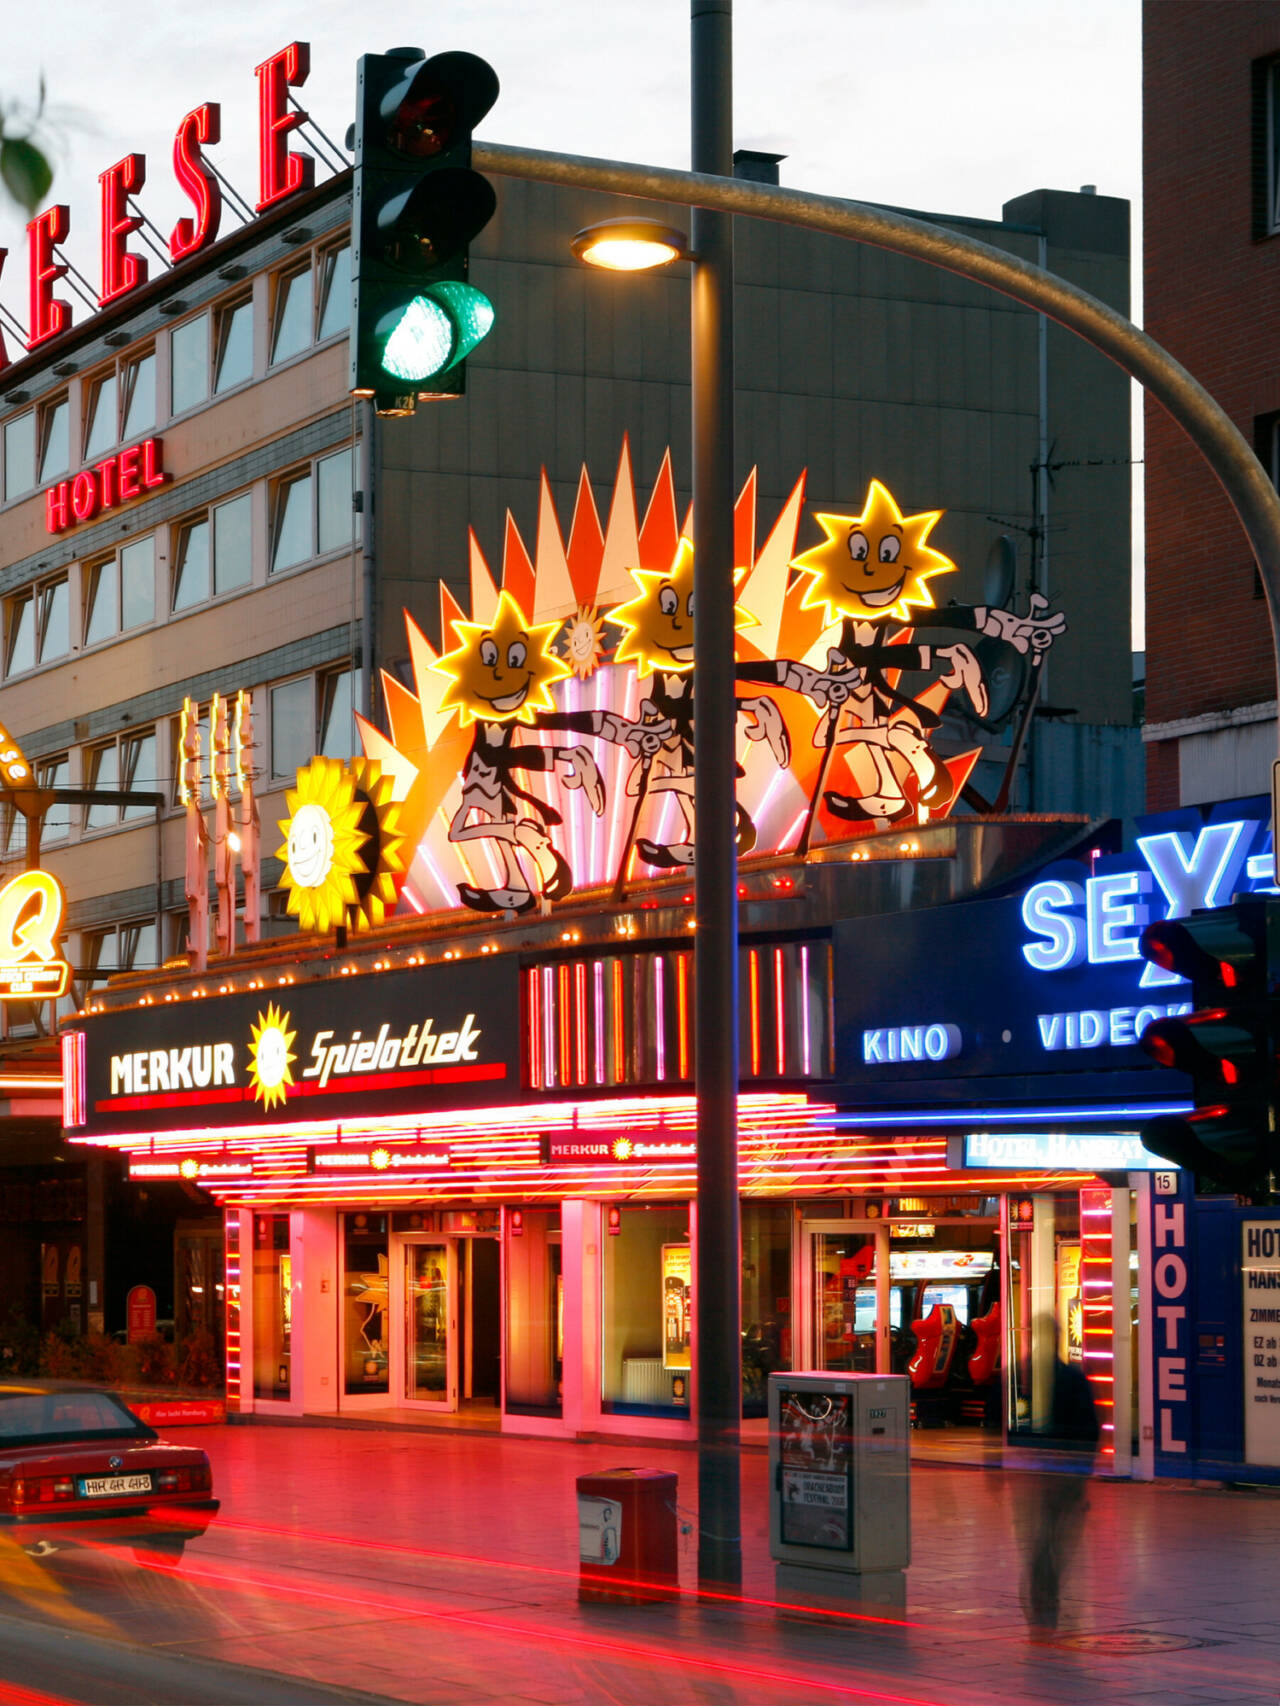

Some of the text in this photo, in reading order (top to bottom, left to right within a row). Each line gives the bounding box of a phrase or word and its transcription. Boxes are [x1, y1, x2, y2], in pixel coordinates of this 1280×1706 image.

[46, 437, 173, 534] HOTEL
[111, 1013, 481, 1095] MERKUR Spielothek
[863, 1023, 954, 1064] KINO
[552, 1144, 609, 1155] MERKUR
[1157, 1175, 1170, 1189] 15
[1155, 1204, 1187, 1453] HOTEL
